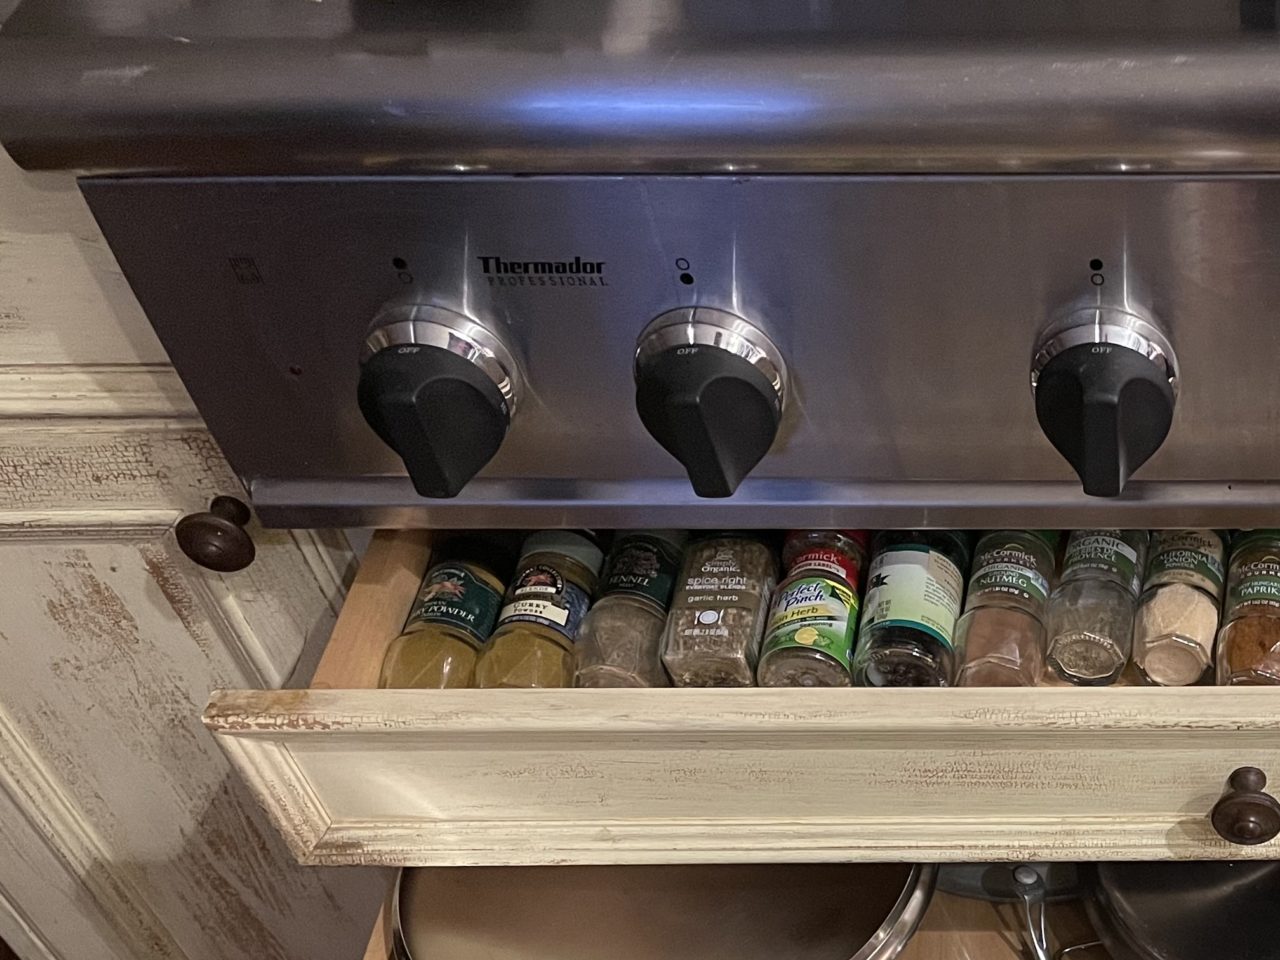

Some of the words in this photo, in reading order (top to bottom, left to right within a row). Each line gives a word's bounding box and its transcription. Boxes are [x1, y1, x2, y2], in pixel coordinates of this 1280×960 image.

[477, 256, 606, 274] Thermador
[486, 276, 609, 286] PROFESSIONAL
[398, 346, 421, 354] OFF
[677, 347, 699, 355] OFF
[1071, 537, 1127, 550] ORGANIC
[1159, 550, 1208, 564] ALIFORNIA
[687, 577, 718, 587] spice
[720, 576, 746, 586] right
[979, 575, 1028, 588] NUTMEG
[687, 595, 714, 603] garlic
[777, 582, 821, 608] Perfect
[513, 601, 549, 610] CURRY
[784, 590, 823, 612] Pinch
[791, 607, 819, 618] Herb
